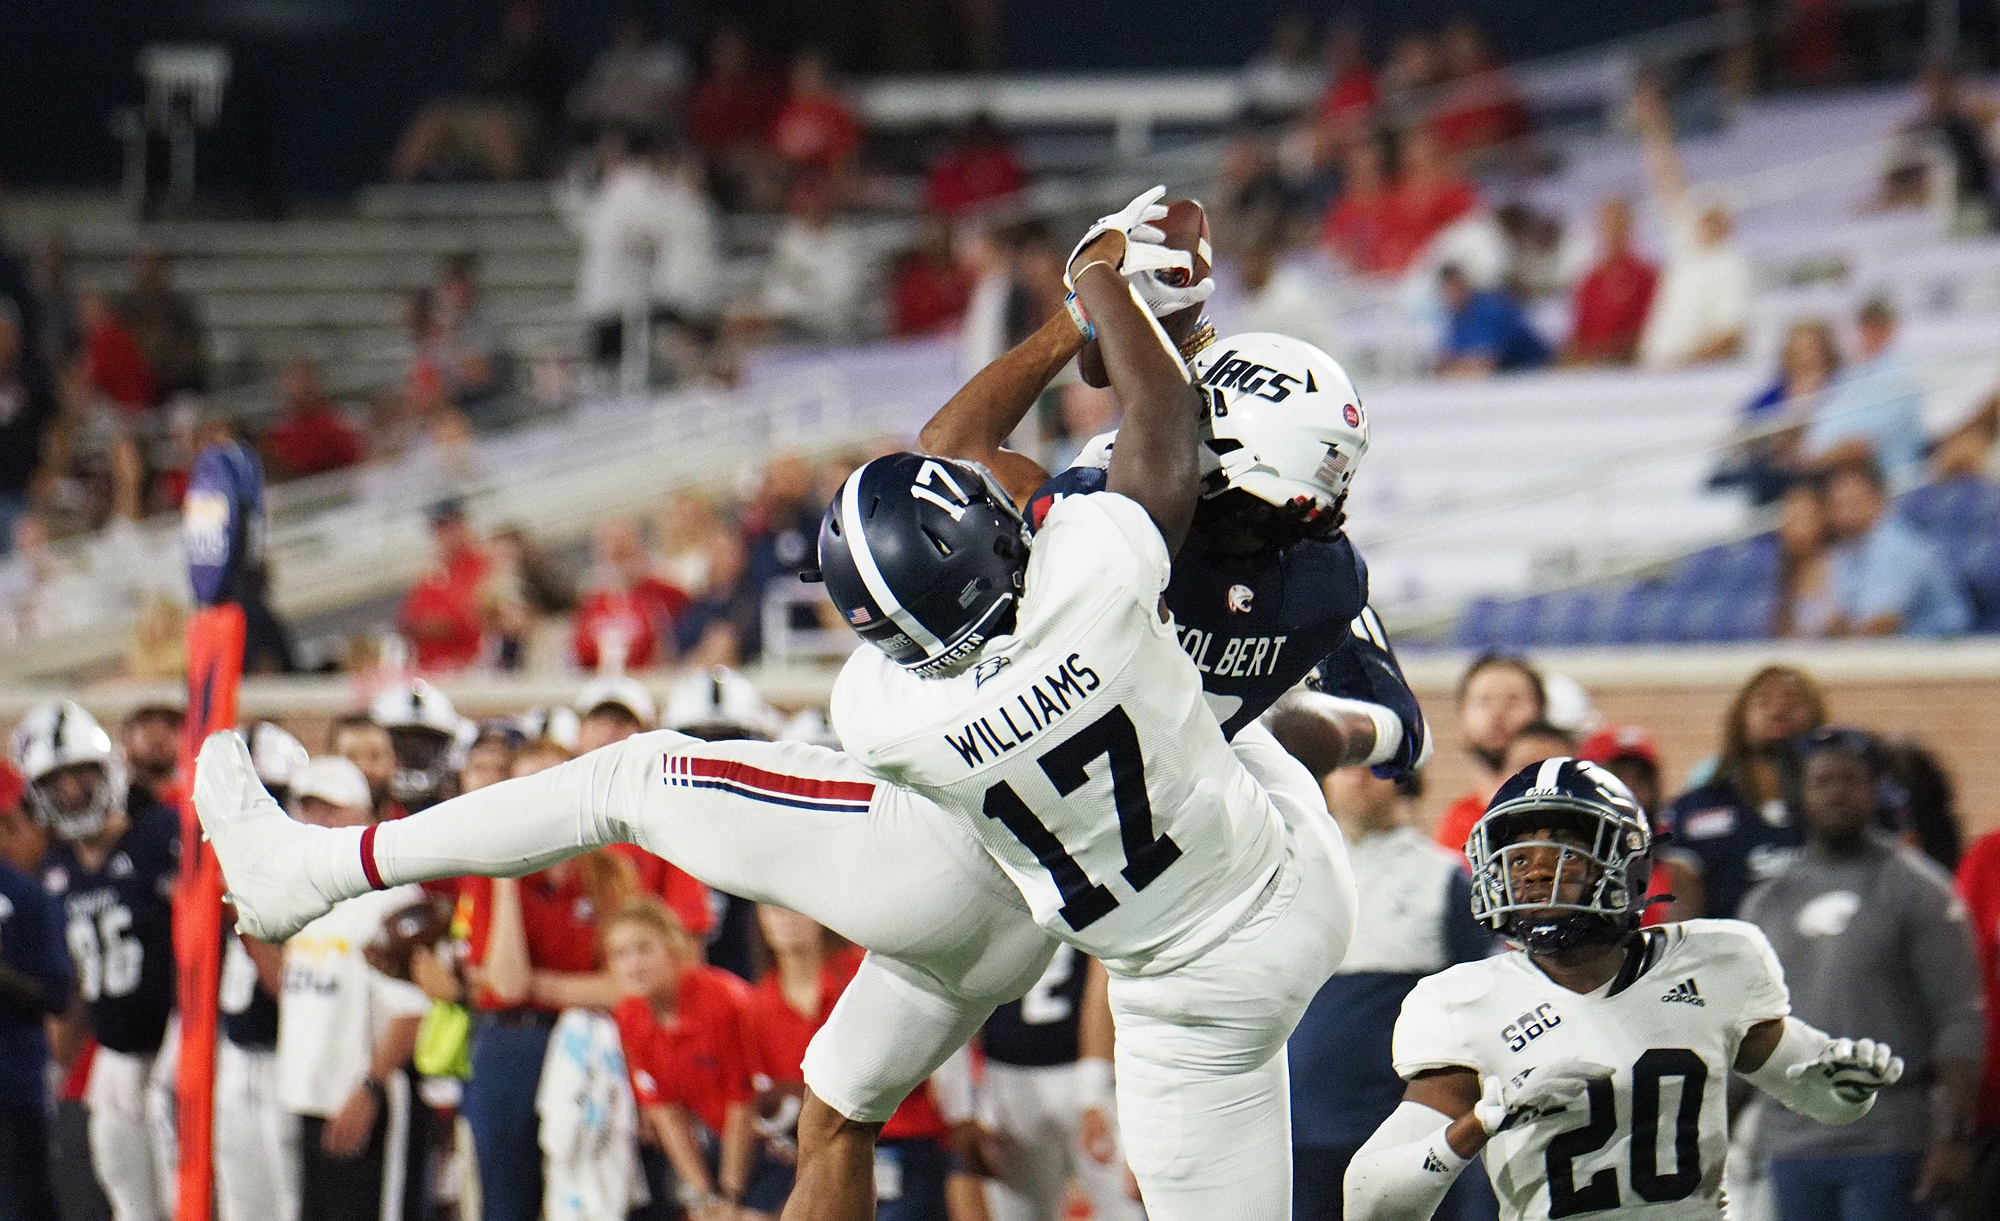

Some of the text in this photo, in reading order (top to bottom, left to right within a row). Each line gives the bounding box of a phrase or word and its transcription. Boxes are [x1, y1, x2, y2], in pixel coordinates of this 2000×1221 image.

[1201, 350, 1303, 402] JAGS
[911, 460, 970, 522] 17
[944, 653, 1101, 769] WILLIAMS
[983, 704, 1184, 932] 17
[1501, 1002, 1563, 1053] SBC
[1661, 992, 1706, 1008] adidas
[1545, 1048, 1709, 1220] 20
